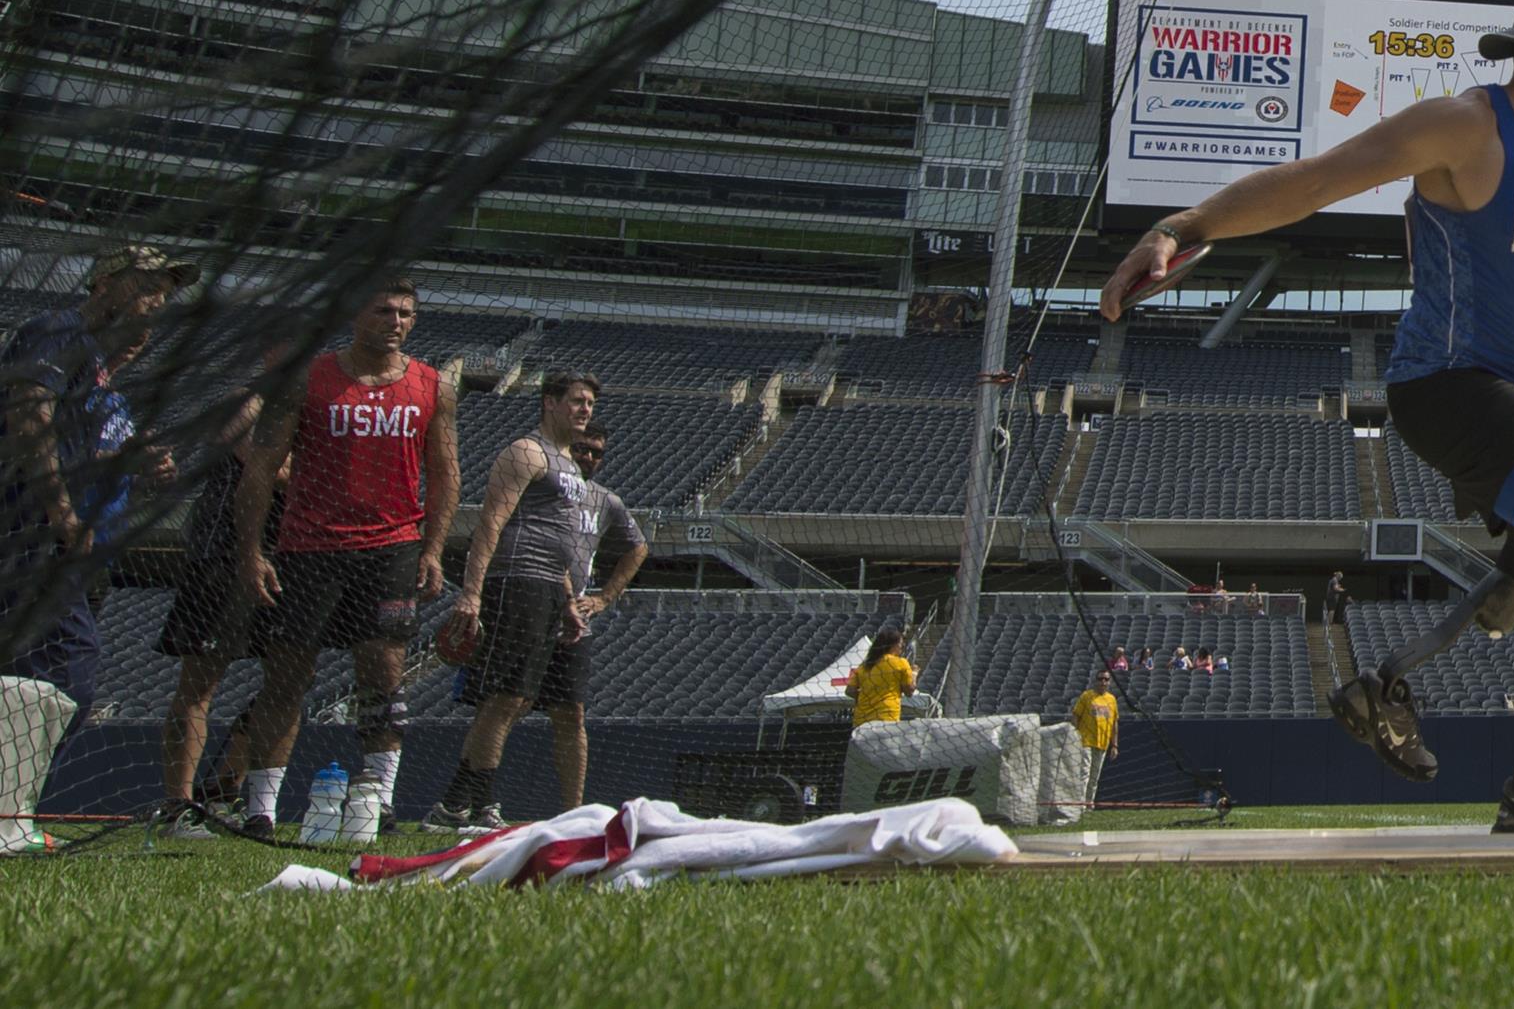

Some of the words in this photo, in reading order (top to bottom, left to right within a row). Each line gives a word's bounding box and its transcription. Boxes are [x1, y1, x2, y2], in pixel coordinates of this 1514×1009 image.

[1152, 16, 1221, 29] DEPARTMENT
[1229, 21, 1240, 30] OF
[1248, 22, 1293, 33] DEFENSE
[1389, 18, 1423, 29] Soldier
[1426, 20, 1450, 31] Field
[1152, 26, 1292, 56] WARRIOR
[1369, 30, 1454, 58] 15:36
[1150, 50, 1290, 85] GAMES
[1437, 62, 1450, 70] PIT
[1474, 59, 1488, 68] PIT
[1491, 60, 1496, 68] 3
[1389, 74, 1404, 82] PIT
[1201, 86, 1232, 95] POWERED
[1170, 99, 1246, 110] BOEING
[1144, 141, 1286, 156] #WARRIORGAMES
[926, 232, 962, 254] Lite
[329, 404, 420, 438] USMC
[690, 527, 710, 539] 122
[1060, 533, 1080, 544] 123
[874, 765, 977, 804] GILL
